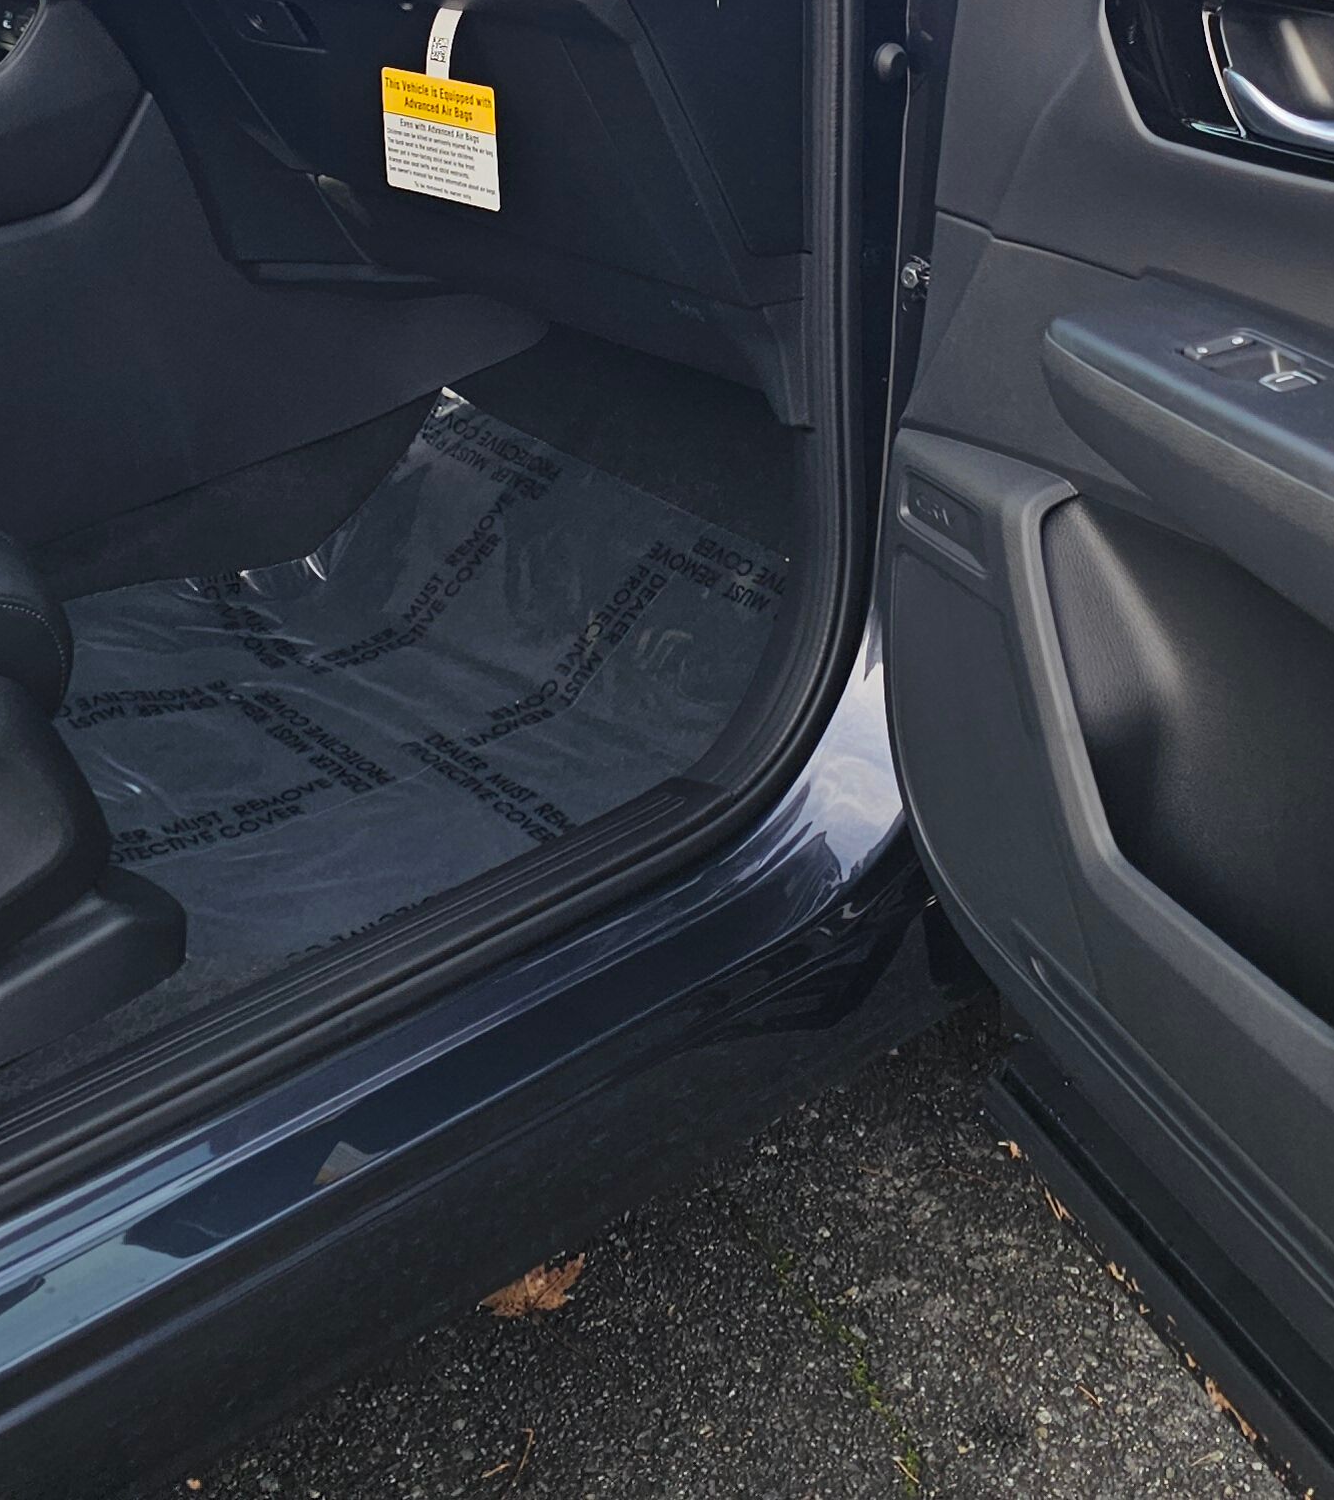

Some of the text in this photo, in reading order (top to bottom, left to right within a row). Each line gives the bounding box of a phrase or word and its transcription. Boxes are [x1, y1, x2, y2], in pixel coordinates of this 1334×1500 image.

[385, 77, 492, 108] This Vehicle is Equipped with
[404, 97, 473, 123] Advanced Air Bags
[400, 118, 413, 129] Even
[415, 122, 426, 131] with
[427, 125, 454, 138] Advanced
[401, 572, 444, 624] MUST
[444, 492, 516, 567] REMOVE
[646, 539, 723, 588] REMOVE
[335, 599, 448, 668] PROTECTIVE
[444, 532, 503, 597] COVER
[554, 563, 651, 677] PROTECTIVE
[603, 572, 667, 646] DEALER
[722, 581, 771, 612] MUST
[560, 650, 604, 708] MUST
[66, 705, 126, 729] MUST
[266, 723, 314, 755] MUST
[306, 725, 398, 785] PROTECTIVE
[308, 754, 375, 794] DEALER
[423, 732, 489, 772] DEALER
[485, 773, 540, 804] MUST
[160, 810, 224, 835] MUST
[231, 777, 334, 818] REMOVE
[492, 800, 558, 844] COVER
[106, 804, 306, 866] OTECTIVE COVER
